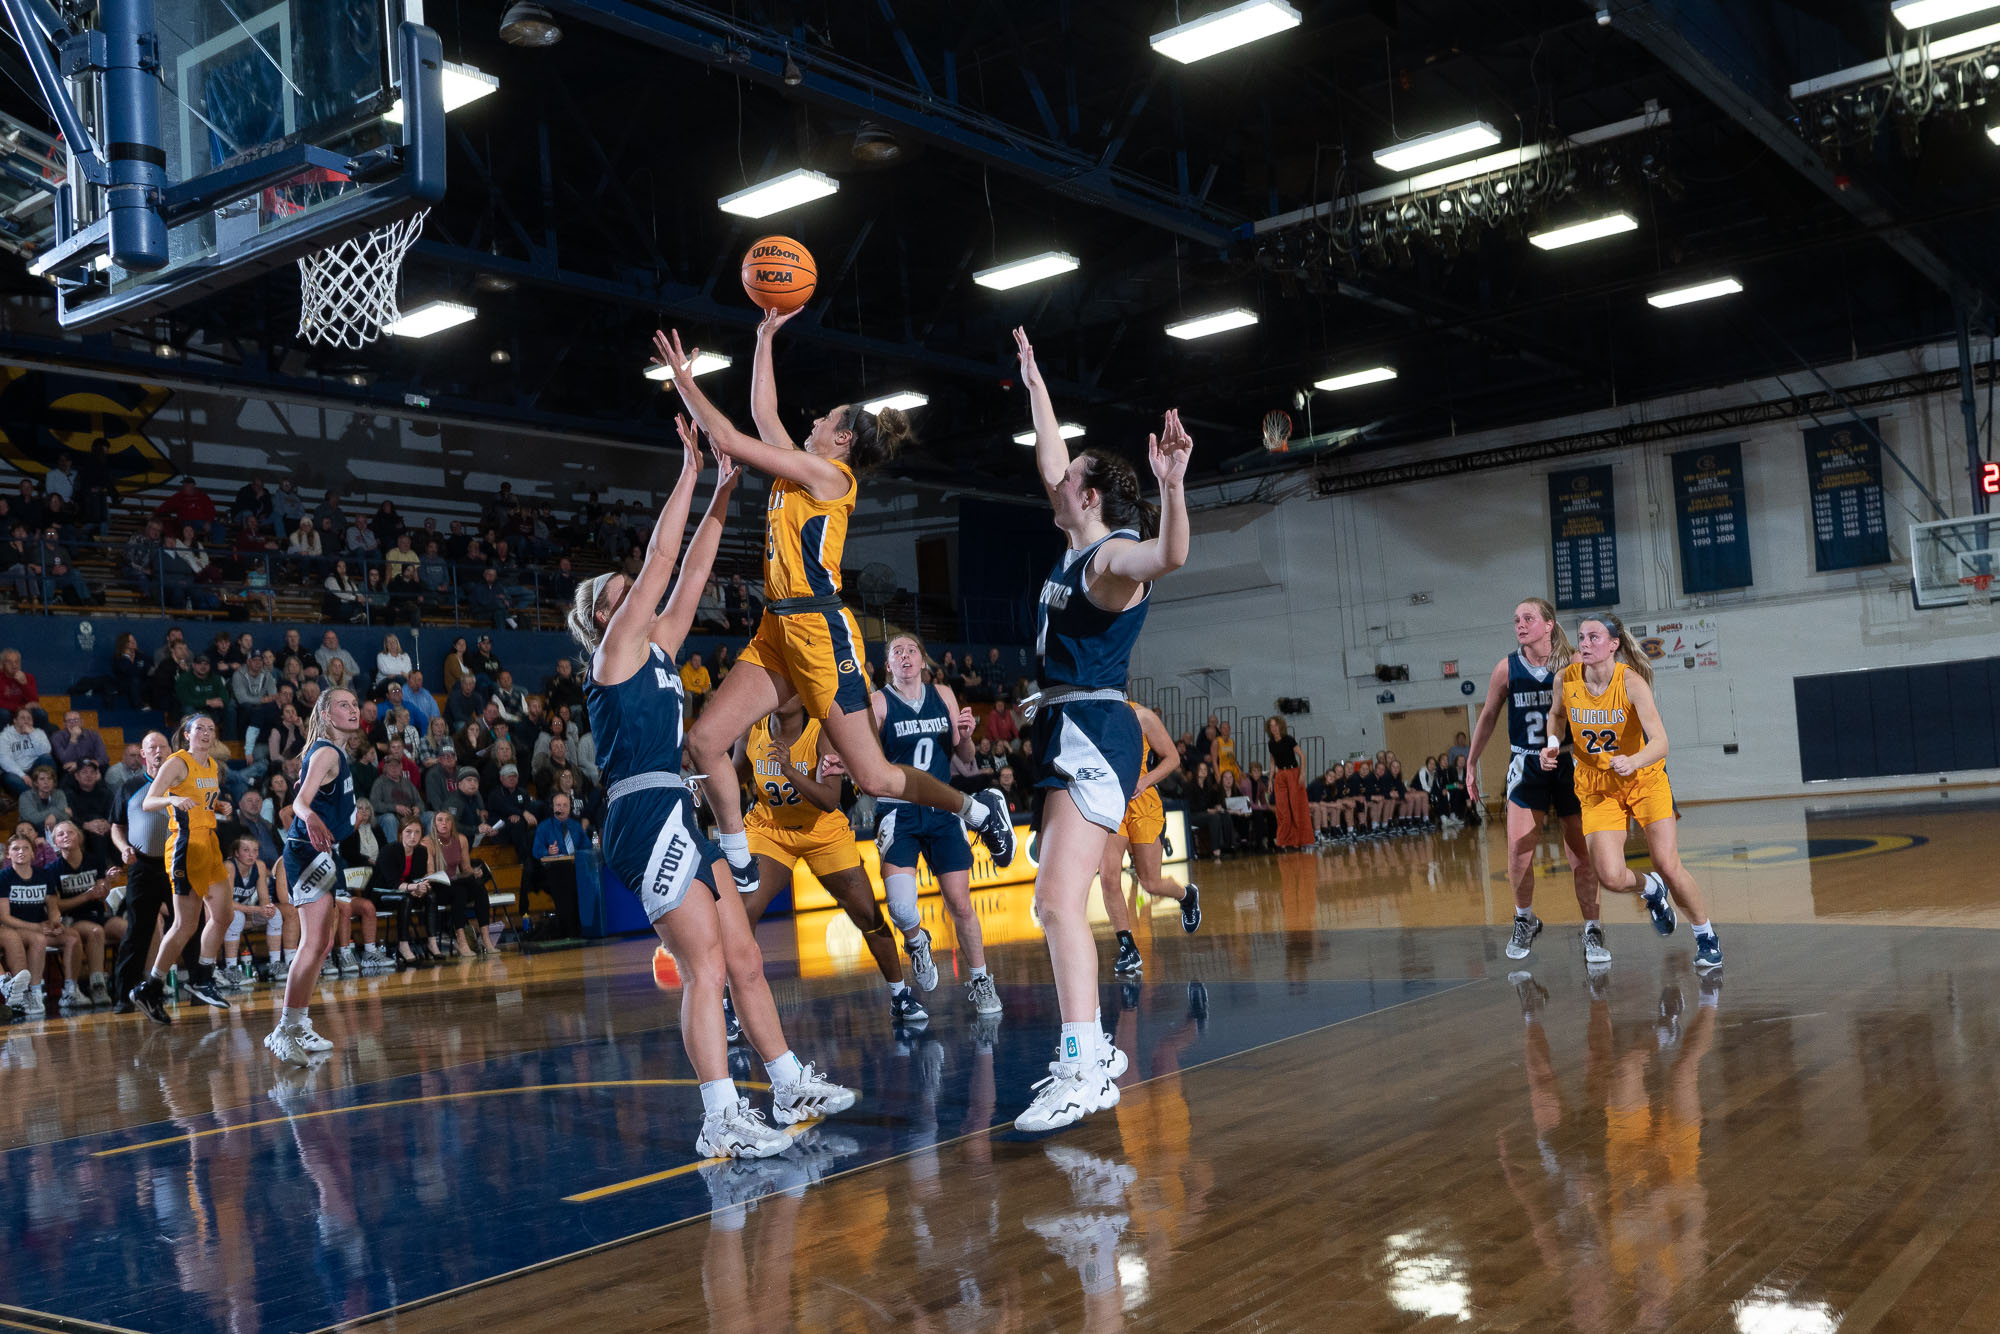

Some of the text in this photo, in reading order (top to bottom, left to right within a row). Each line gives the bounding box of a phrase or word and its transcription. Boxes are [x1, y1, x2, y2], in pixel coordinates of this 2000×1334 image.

[753, 246, 800, 263] Wilson
[756, 270, 793, 283] NCAA
[1691, 513, 1733, 526] 1972 1980
[1692, 523, 1735, 537] 1981 1989
[1692, 534, 1736, 547] 1990 2000
[1581, 591, 1596, 599] 2020
[1513, 691, 1538, 708] BLUE
[1571, 707, 1626, 725] BLUGOLDS
[894, 716, 949, 738] BLUE DEVILS
[1525, 711, 1549, 745] 2
[1581, 729, 1620, 754] 22
[913, 737, 934, 771] 0
[764, 781, 805, 807] 32
[653, 834, 688, 896] STOUT
[62, 871, 98, 888] STOUT
[301, 859, 332, 894] STOUT
[11, 887, 46, 899] STOUT
